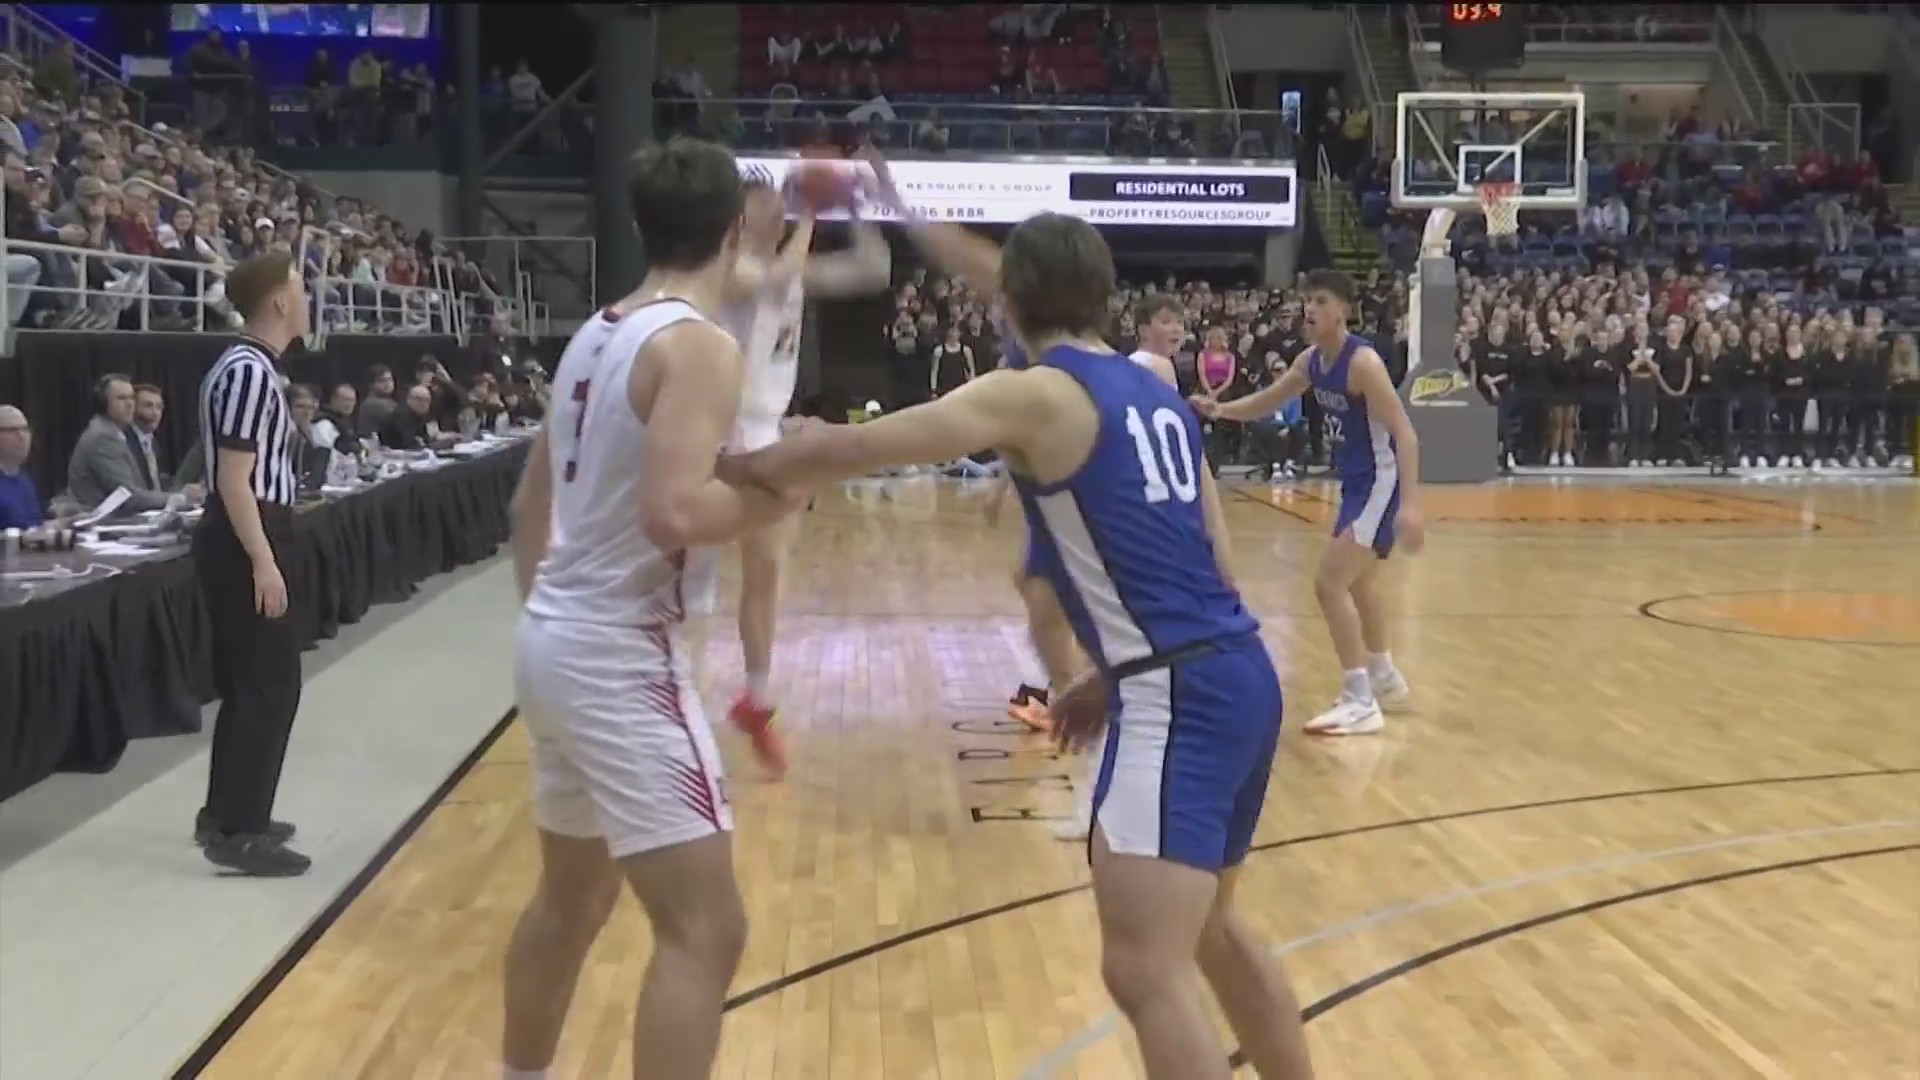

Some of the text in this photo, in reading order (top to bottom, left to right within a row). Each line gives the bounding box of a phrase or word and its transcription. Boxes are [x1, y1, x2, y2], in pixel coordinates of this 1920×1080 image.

[1115, 181, 1245, 196] RESIDENTIAL LOTS
[1126, 405, 1198, 503] 10
